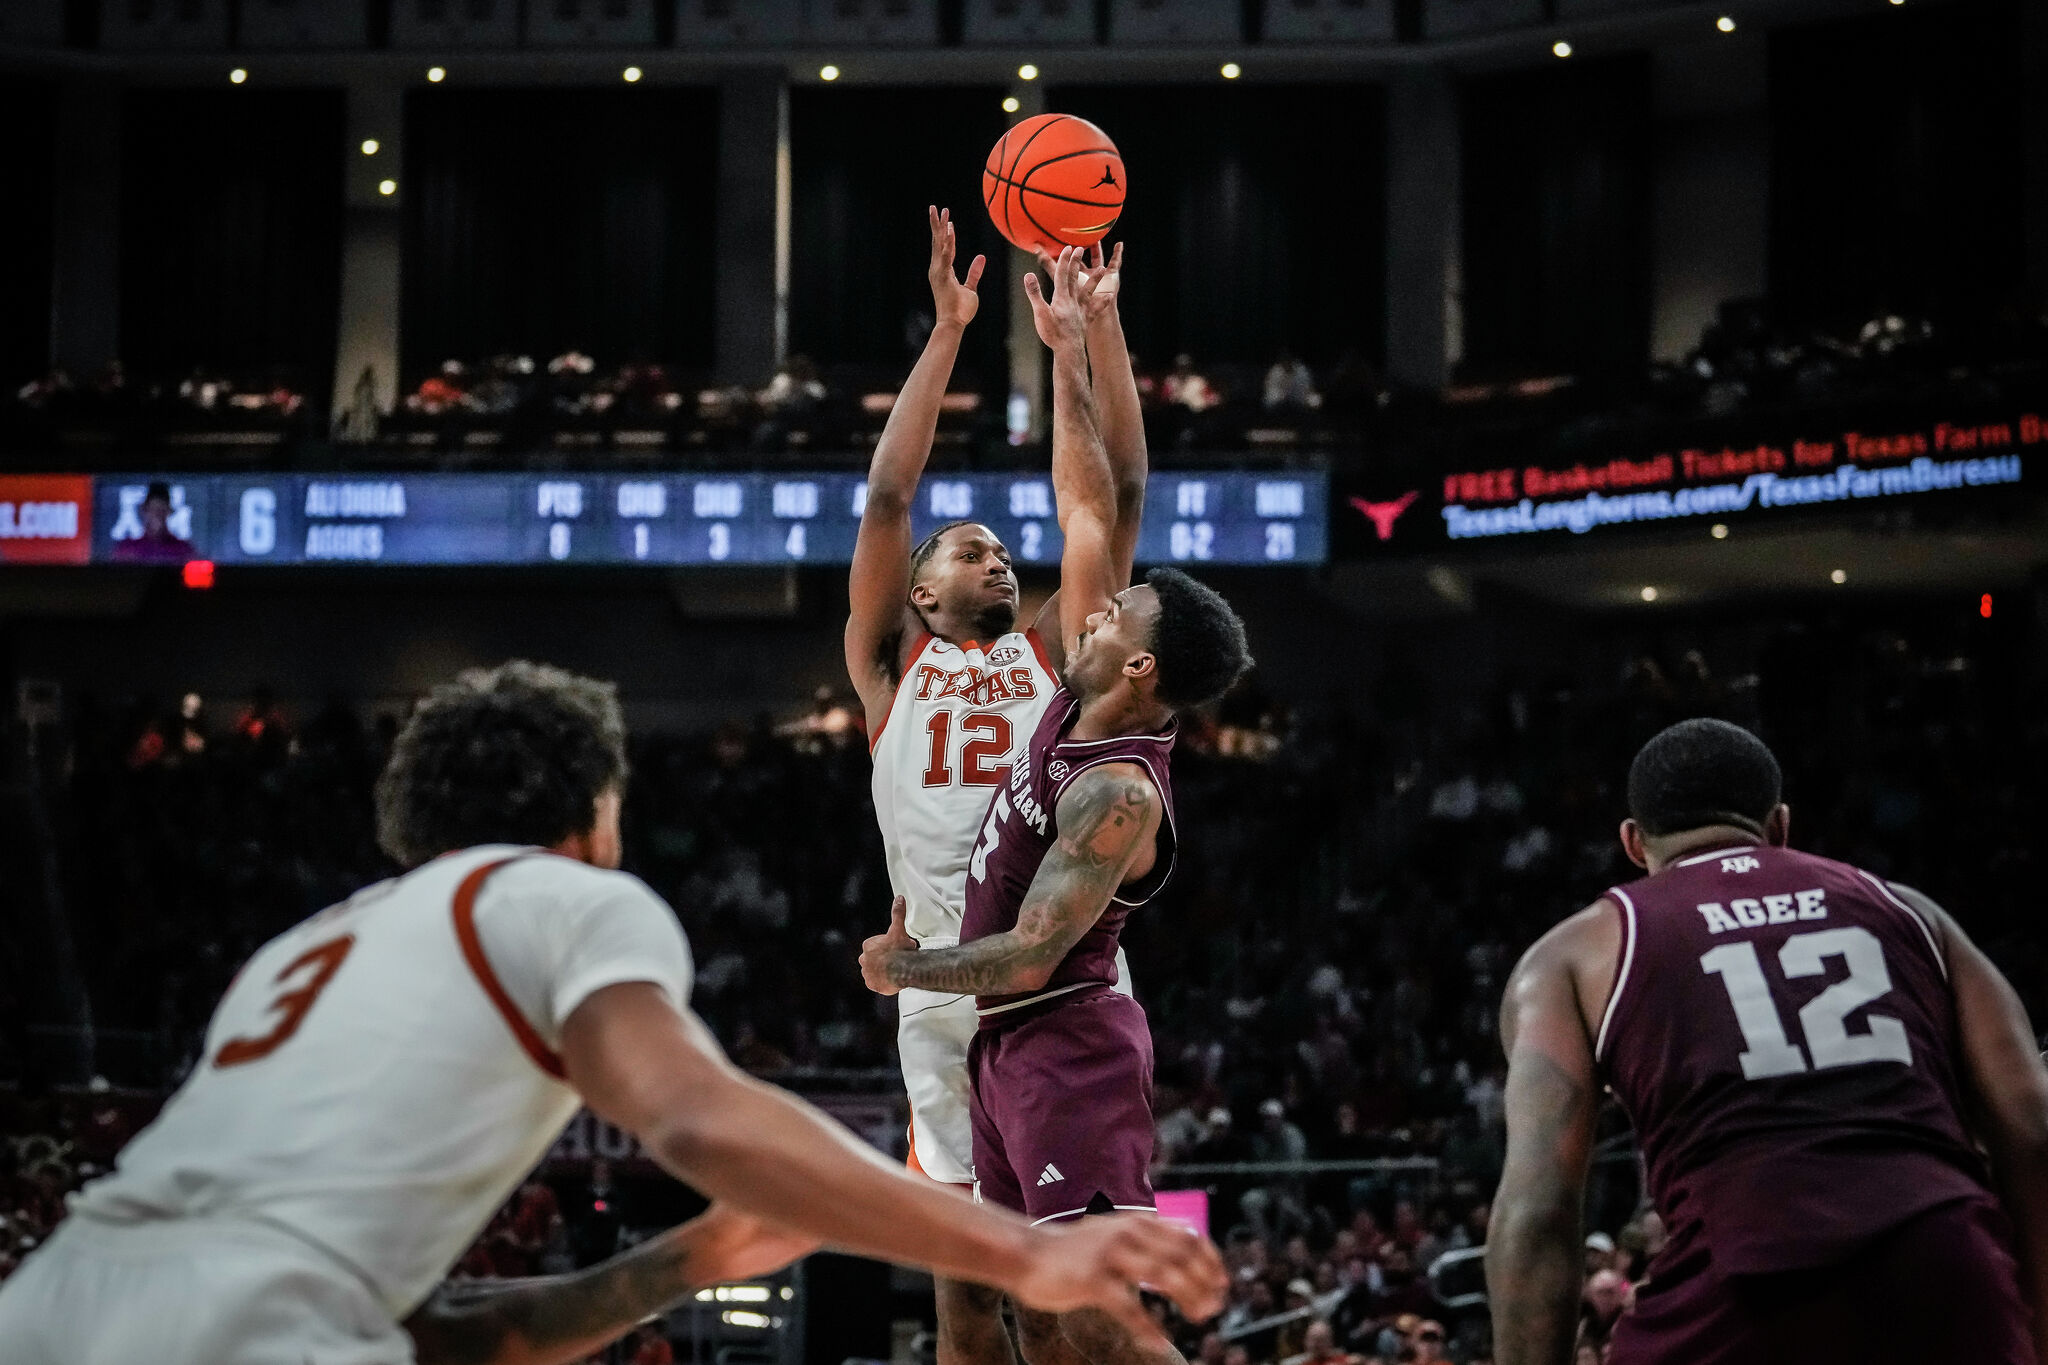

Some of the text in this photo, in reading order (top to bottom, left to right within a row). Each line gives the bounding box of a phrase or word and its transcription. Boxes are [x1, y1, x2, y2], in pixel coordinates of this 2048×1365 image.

[1443, 469, 1515, 501] FREE
[1522, 454, 1674, 496] Basketball
[1792, 437, 1836, 467] for
[1844, 430, 1928, 461] Texas
[1934, 421, 2012, 451] Farm
[238, 487, 277, 556] 6
[633, 522, 651, 560] 1
[784, 523, 808, 560] 4
[1020, 521, 1043, 560] 2
[915, 663, 1038, 706] TEXAS
[991, 648, 1020, 662] SEC
[922, 709, 1013, 788] 12
[970, 788, 1011, 885] 5
[1012, 783, 1048, 836] A&M
[1697, 888, 1828, 934] AGEE
[212, 934, 355, 1068] 3
[1700, 926, 1913, 1081] 12
